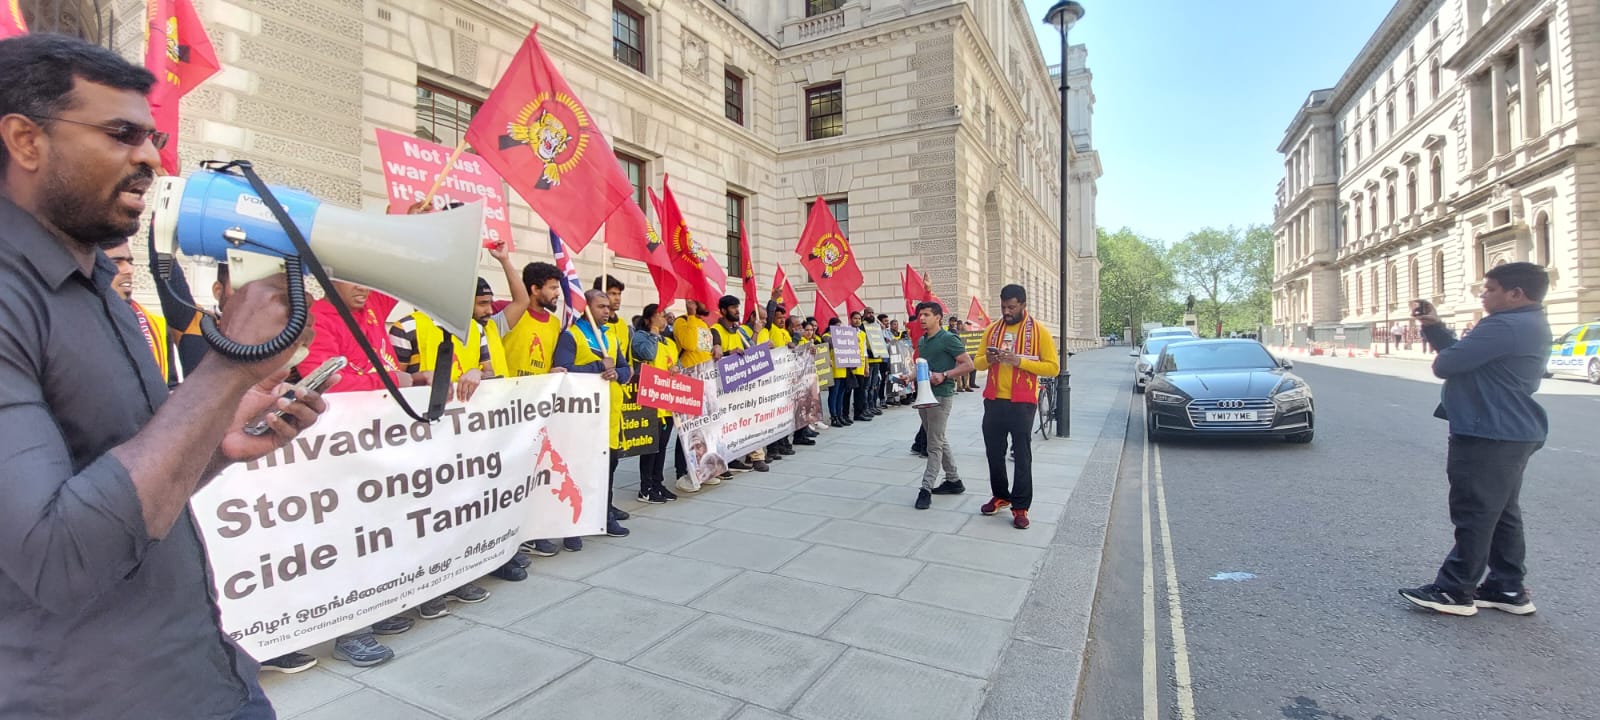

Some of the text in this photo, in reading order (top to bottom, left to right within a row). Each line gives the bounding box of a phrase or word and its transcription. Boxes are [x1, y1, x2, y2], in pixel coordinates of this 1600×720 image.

[403, 141, 442, 165] Not
[387, 161, 428, 182] war
[530, 359, 544, 369] FREE
[724, 360, 739, 373] Rape
[739, 357, 745, 366] is
[745, 352, 759, 364] Used
[758, 350, 766, 359] to
[725, 369, 748, 385] Destroy
[751, 360, 770, 373] Nation
[653, 374, 671, 388] Tamil
[671, 379, 692, 393] Eelam
[640, 385, 647, 397] is
[648, 388, 660, 402] the
[660, 391, 675, 404] only
[675, 394, 701, 408] solution
[641, 417, 649, 428] is
[681, 416, 709, 433] Where
[728, 399, 757, 412] Forcibly
[739, 416, 752, 427] for
[754, 410, 775, 423] Tamil
[1212, 412, 1251, 420] YM17 YME
[247, 418, 433, 471] nvaded
[216, 448, 502, 539] Stop ongoing
[223, 543, 338, 600] cide
[354, 525, 394, 558] in
[257, 633, 291, 647] Tamils
[293, 612, 355, 637] Coordinating
[356, 596, 399, 616] Committee
[400, 587, 416, 601] (UK)
